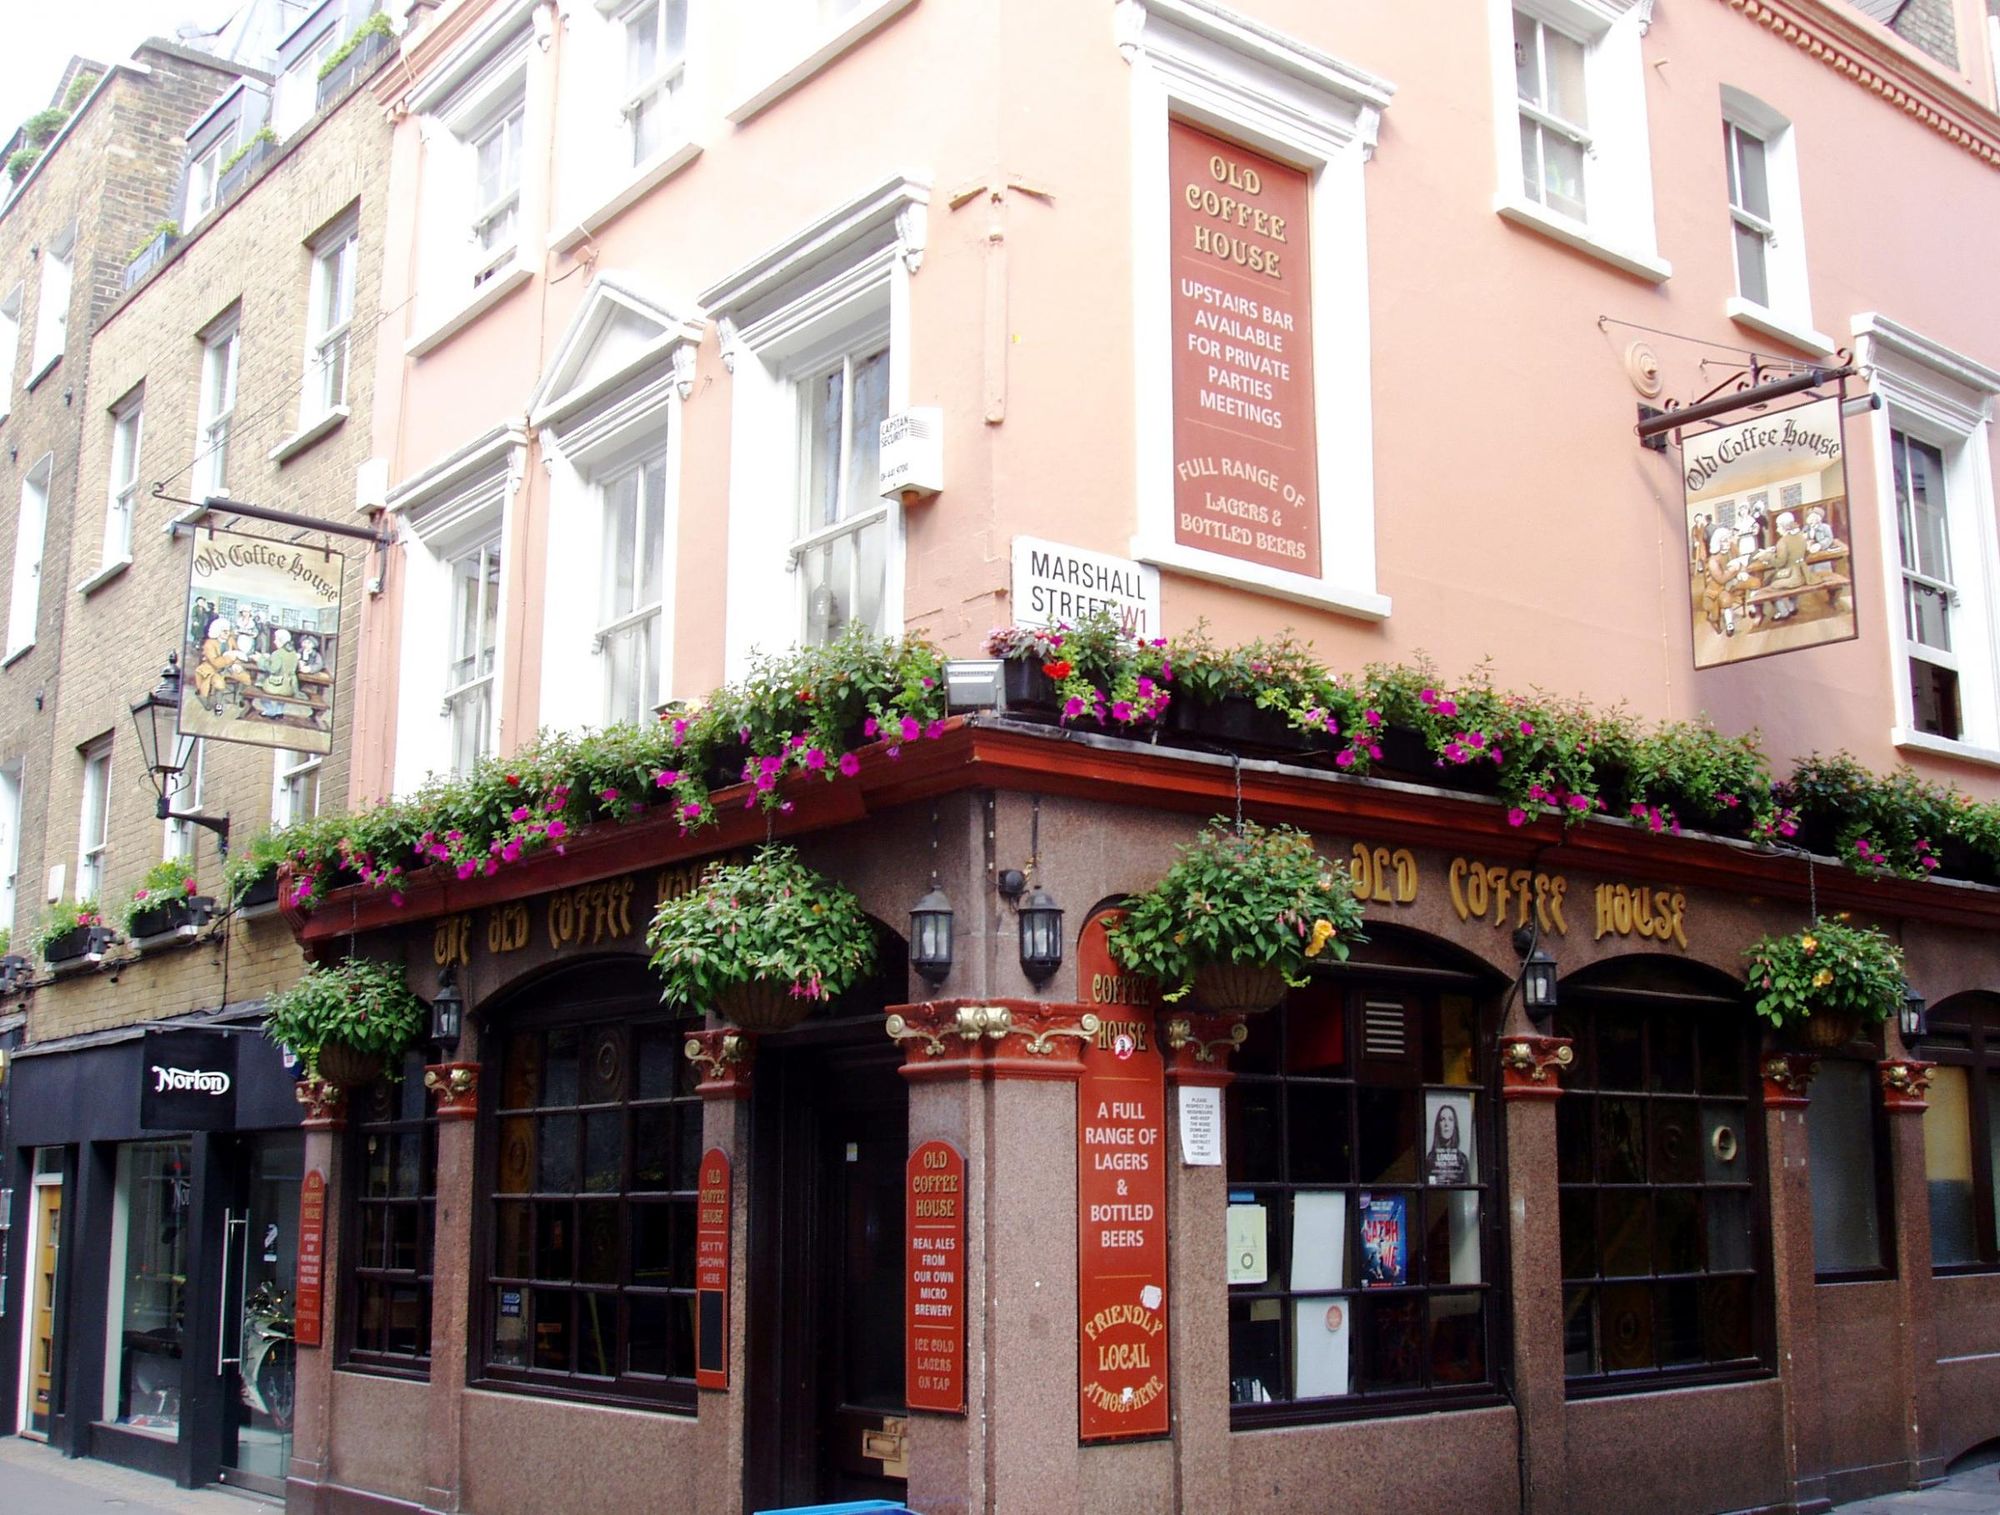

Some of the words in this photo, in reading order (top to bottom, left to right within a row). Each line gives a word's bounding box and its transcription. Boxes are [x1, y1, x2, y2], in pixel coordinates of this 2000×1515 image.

[1209, 155, 1261, 195] OLD
[1185, 183, 1287, 244] COFFEE
[1194, 224, 1281, 280] HOUSE
[1181, 278, 1258, 319] UPSTAIRS
[1262, 305, 1294, 332] BAR
[1195, 309, 1283, 353] AVAILABLE
[1188, 333, 1221, 360] FOR
[1225, 344, 1290, 381] PRIVATE
[1208, 365, 1273, 401] PARTIES
[1200, 389, 1282, 429] MEETINGS
[1686, 453, 1718, 491] Old
[1718, 427, 1778, 464] Coffee
[1177, 457, 1218, 482] FULL
[1221, 458, 1279, 492] RANGE
[1283, 484, 1306, 508] OF
[1205, 491, 1269, 524] LAGERS
[1271, 509, 1282, 527] &
[1180, 512, 1252, 546] BOTTLED
[1256, 531, 1306, 559] BEERS
[194, 547, 227, 577] Old
[229, 544, 287, 569] Coffee
[1031, 550, 1146, 600] MARSHALL
[1120, 603, 1147, 634] W1
[1350, 842, 1418, 903] OLD
[1449, 857, 1568, 936] COFFEE
[1594, 882, 1688, 951] HOUSE
[488, 904, 531, 954] OLD
[548, 878, 635, 950] COFFEE
[1092, 973, 1150, 1005] COFFEE
[152, 1065, 230, 1095] Norton
[1097, 1102, 1109, 1119] A
[1112, 1102, 1146, 1120] FULL
[1085, 1127, 1135, 1145] RANGE
[1138, 1128, 1158, 1145] OF
[923, 1151, 948, 1169] OLD
[1094, 1153, 1149, 1171] LAGERS
[707, 1169, 721, 1184] OLD
[912, 1175, 959, 1193] COFFEE
[1116, 1178, 1128, 1196] &
[916, 1199, 955, 1218] HOUSE
[1090, 1204, 1153, 1222] BOTTLED
[913, 1237, 933, 1250] REAL
[935, 1237, 955, 1250] ALES
[1101, 1230, 1144, 1248] BEERS
[922, 1254, 946, 1267] FROM
[703, 1272, 721, 1284] HERE
[914, 1270, 932, 1283] OUR
[933, 1270, 954, 1283] OWN
[920, 1287, 947, 1300] MICRO
[914, 1303, 953, 1317] BREWERY
[1085, 1304, 1163, 1341] FRIENDLY
[914, 1338, 929, 1352] ICE
[930, 1338, 955, 1353] COLD
[1098, 1343, 1151, 1371] LOCAL
[917, 1357, 952, 1372] LAGERS
[918, 1375, 931, 1389] ON
[933, 1377, 951, 1391] TAP
